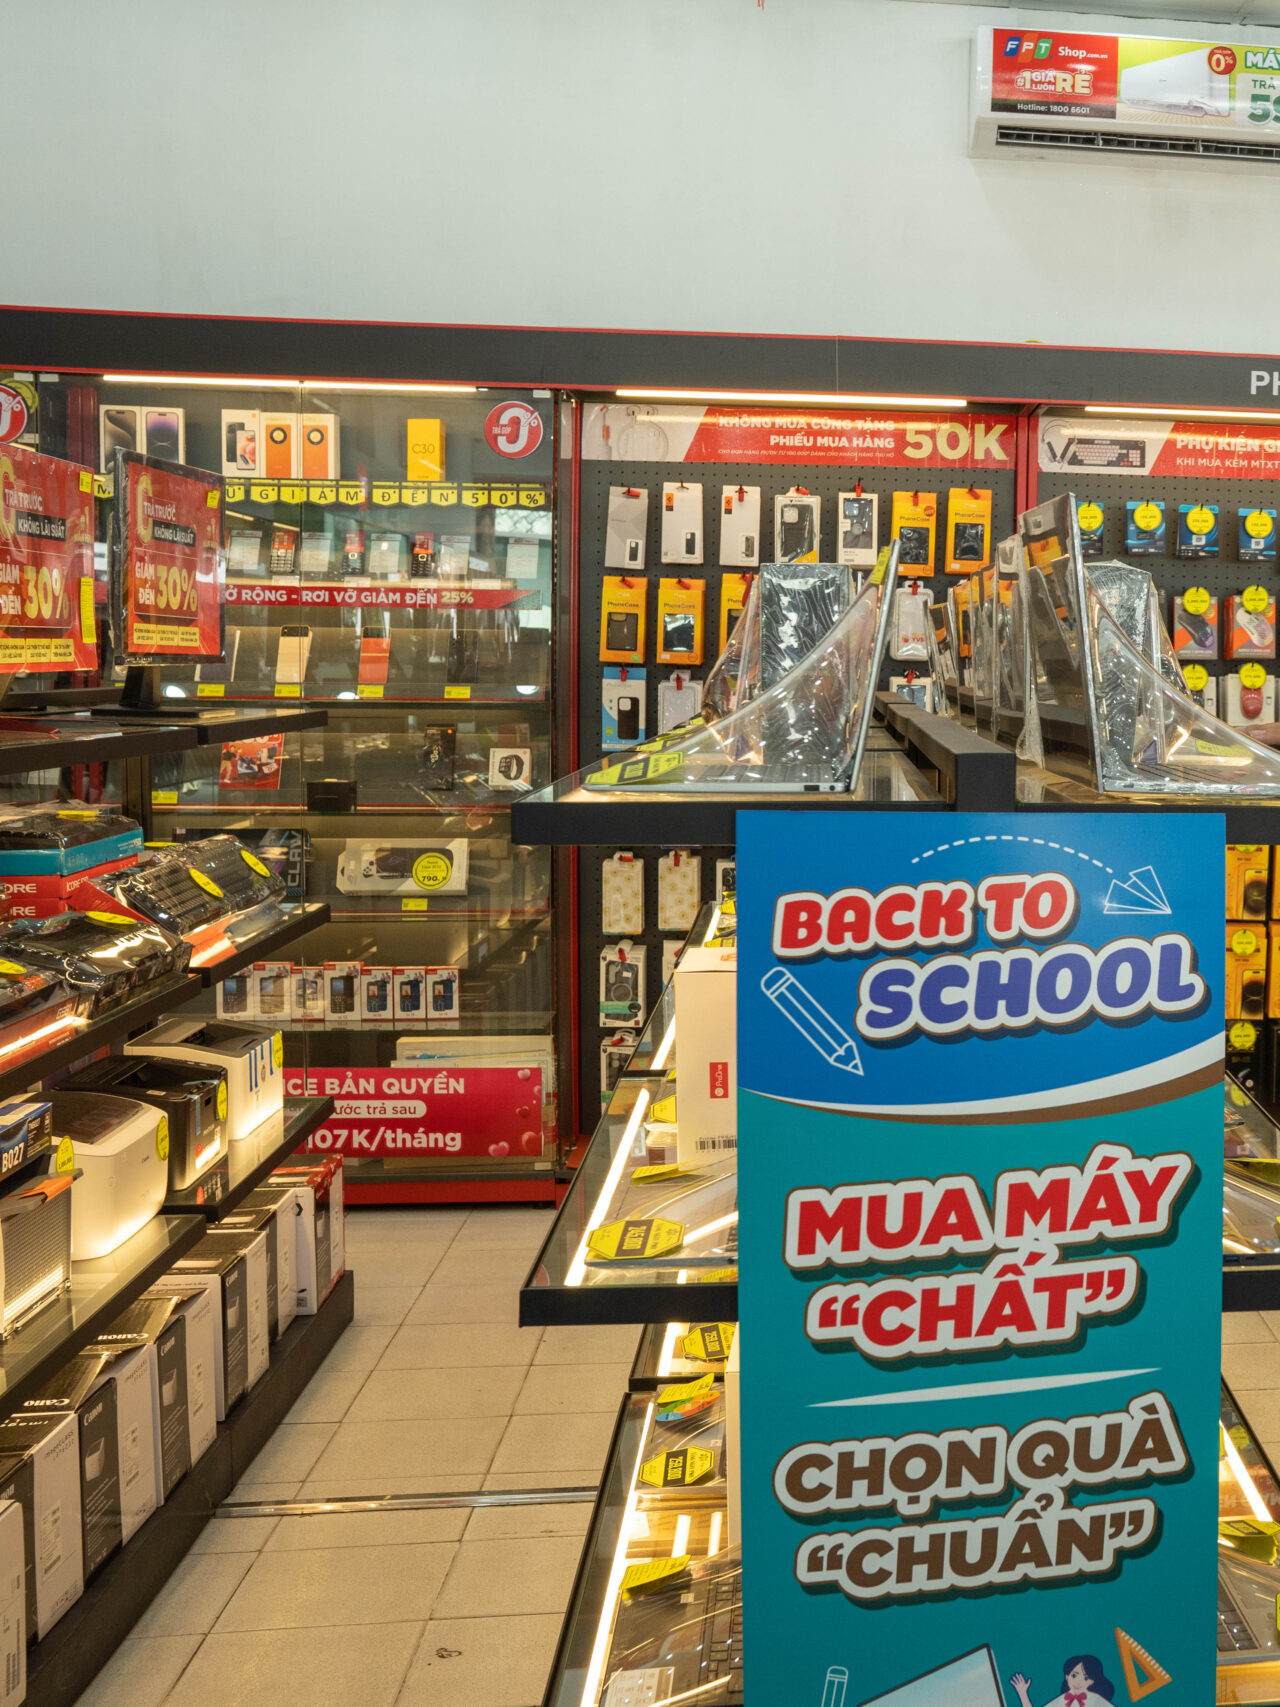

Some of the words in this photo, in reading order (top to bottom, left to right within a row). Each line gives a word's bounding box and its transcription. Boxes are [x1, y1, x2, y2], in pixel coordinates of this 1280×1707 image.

[1211, 54, 1234, 72] 0%
[1017, 103, 1048, 112] Hotline:
[1049, 105, 1069, 113] 1800
[1071, 106, 1090, 114] 6601
[412, 443, 435, 455] C30
[718, 415, 772, 429] KHÔNG
[775, 418, 808, 429] MUA
[902, 421, 1009, 461] 50K
[770, 431, 814, 448] PHIẾU
[817, 436, 850, 448] MUA
[852, 433, 895, 449] HÀNG
[1176, 436, 1215, 453] PHỤ
[1176, 457, 1195, 467] KHI
[1197, 458, 1222, 469] MUA
[1250, 459, 1280, 471] MTXT
[18, 515, 40, 534] KHÔNG
[154, 525, 174, 542] KHÔNG
[23, 565, 69, 620] 30%
[135, 555, 155, 580] GIẢM
[156, 564, 198, 612] 30%
[138, 583, 155, 606] ĐẾN
[240, 587, 288, 605] RỘNG
[301, 589, 330, 603] RƠI
[333, 588, 357, 603] VỠ
[360, 588, 401, 605] GIẢM
[404, 587, 438, 606] ĐẾN
[440, 589, 474, 605] 25%
[776, 883, 972, 953] BACK
[981, 876, 1072, 938] TO
[861, 937, 1201, 1035] SCHOOL
[325, 1072, 376, 1095] BẢN
[382, 1070, 466, 1096] QUYỀN
[366, 1101, 389, 1116] trả
[392, 1104, 417, 1116] sau
[2, 1142, 25, 1173] B027
[793, 1183, 987, 1260] MUA
[1002, 1151, 1184, 1241] MÁY
[84, 1402, 103, 1427] Canon
[781, 1432, 1000, 1508] CHỌN
[1013, 1398, 1178, 1483] QUÀ
